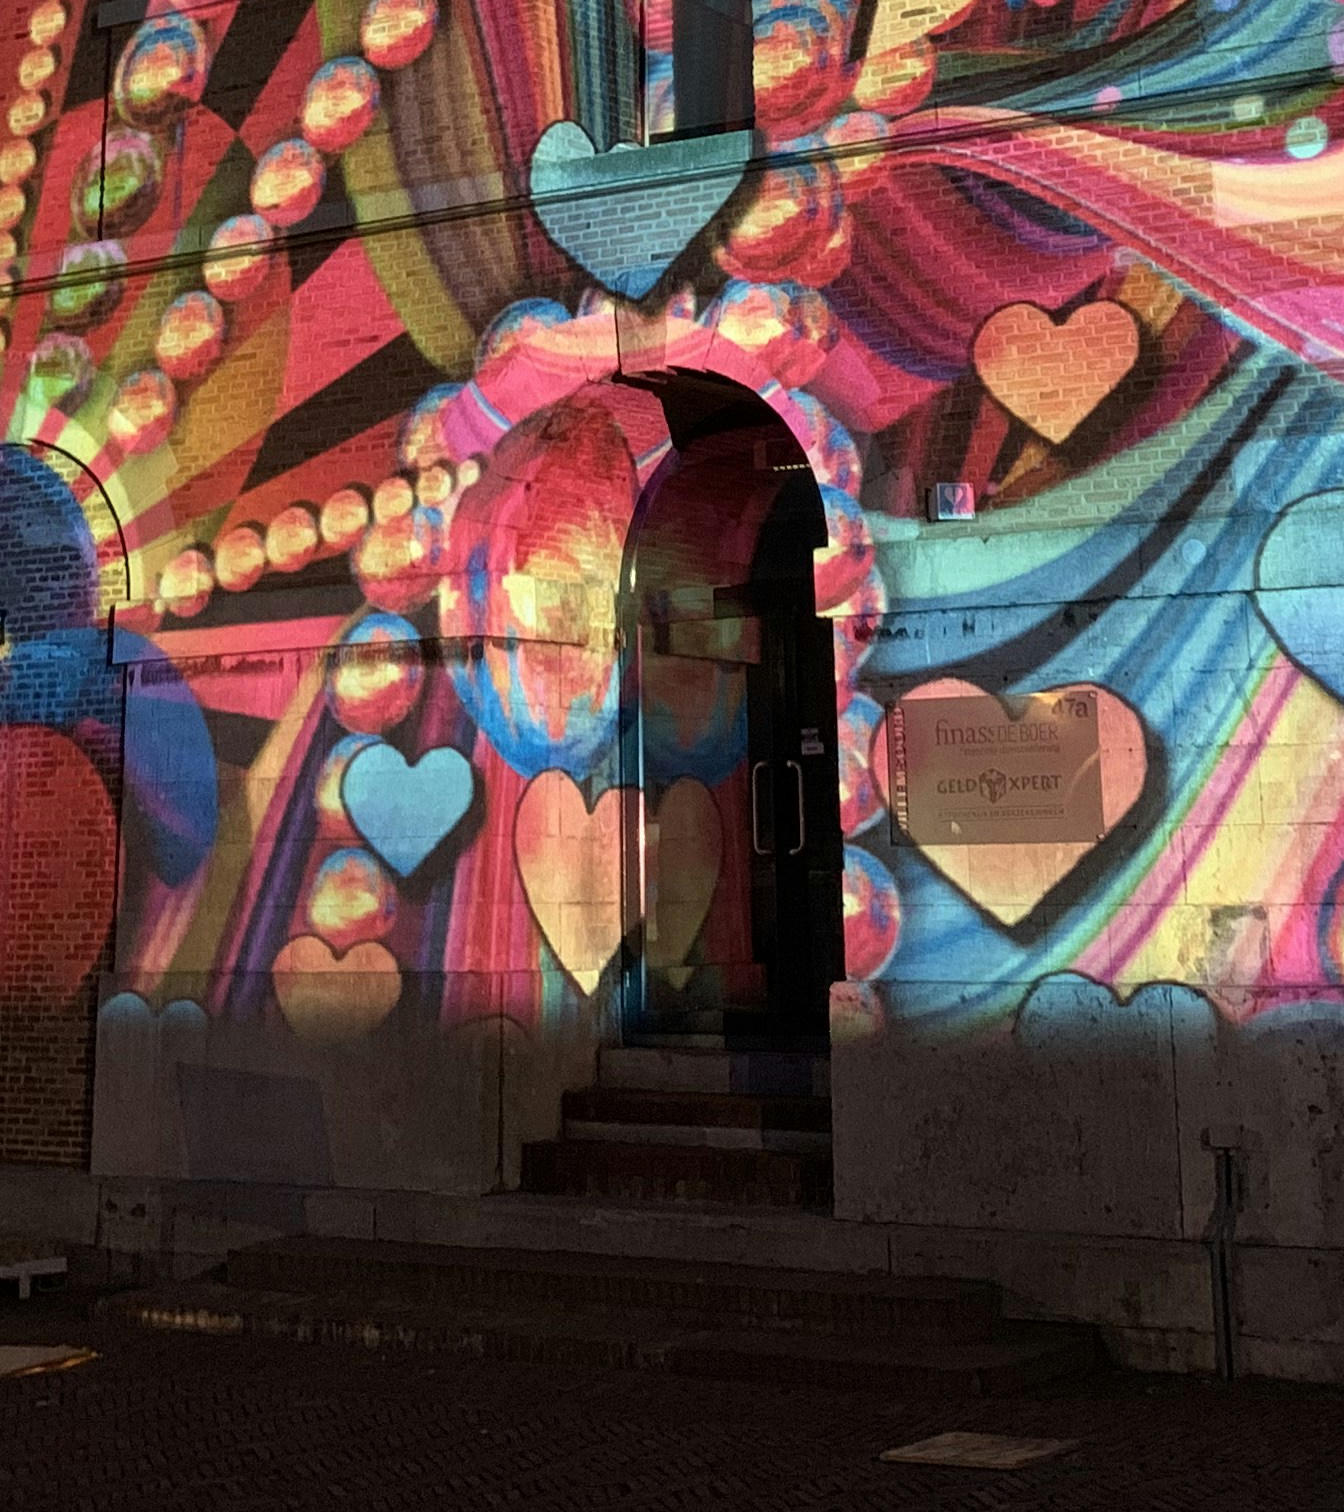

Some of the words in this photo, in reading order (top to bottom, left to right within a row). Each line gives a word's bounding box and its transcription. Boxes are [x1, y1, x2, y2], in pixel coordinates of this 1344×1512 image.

[1051, 697, 1089, 718] 47a
[997, 724, 1017, 744] DE
[1019, 721, 1059, 743] BOER
[937, 777, 978, 795] GELD
[1009, 774, 1062, 792] XPERT
